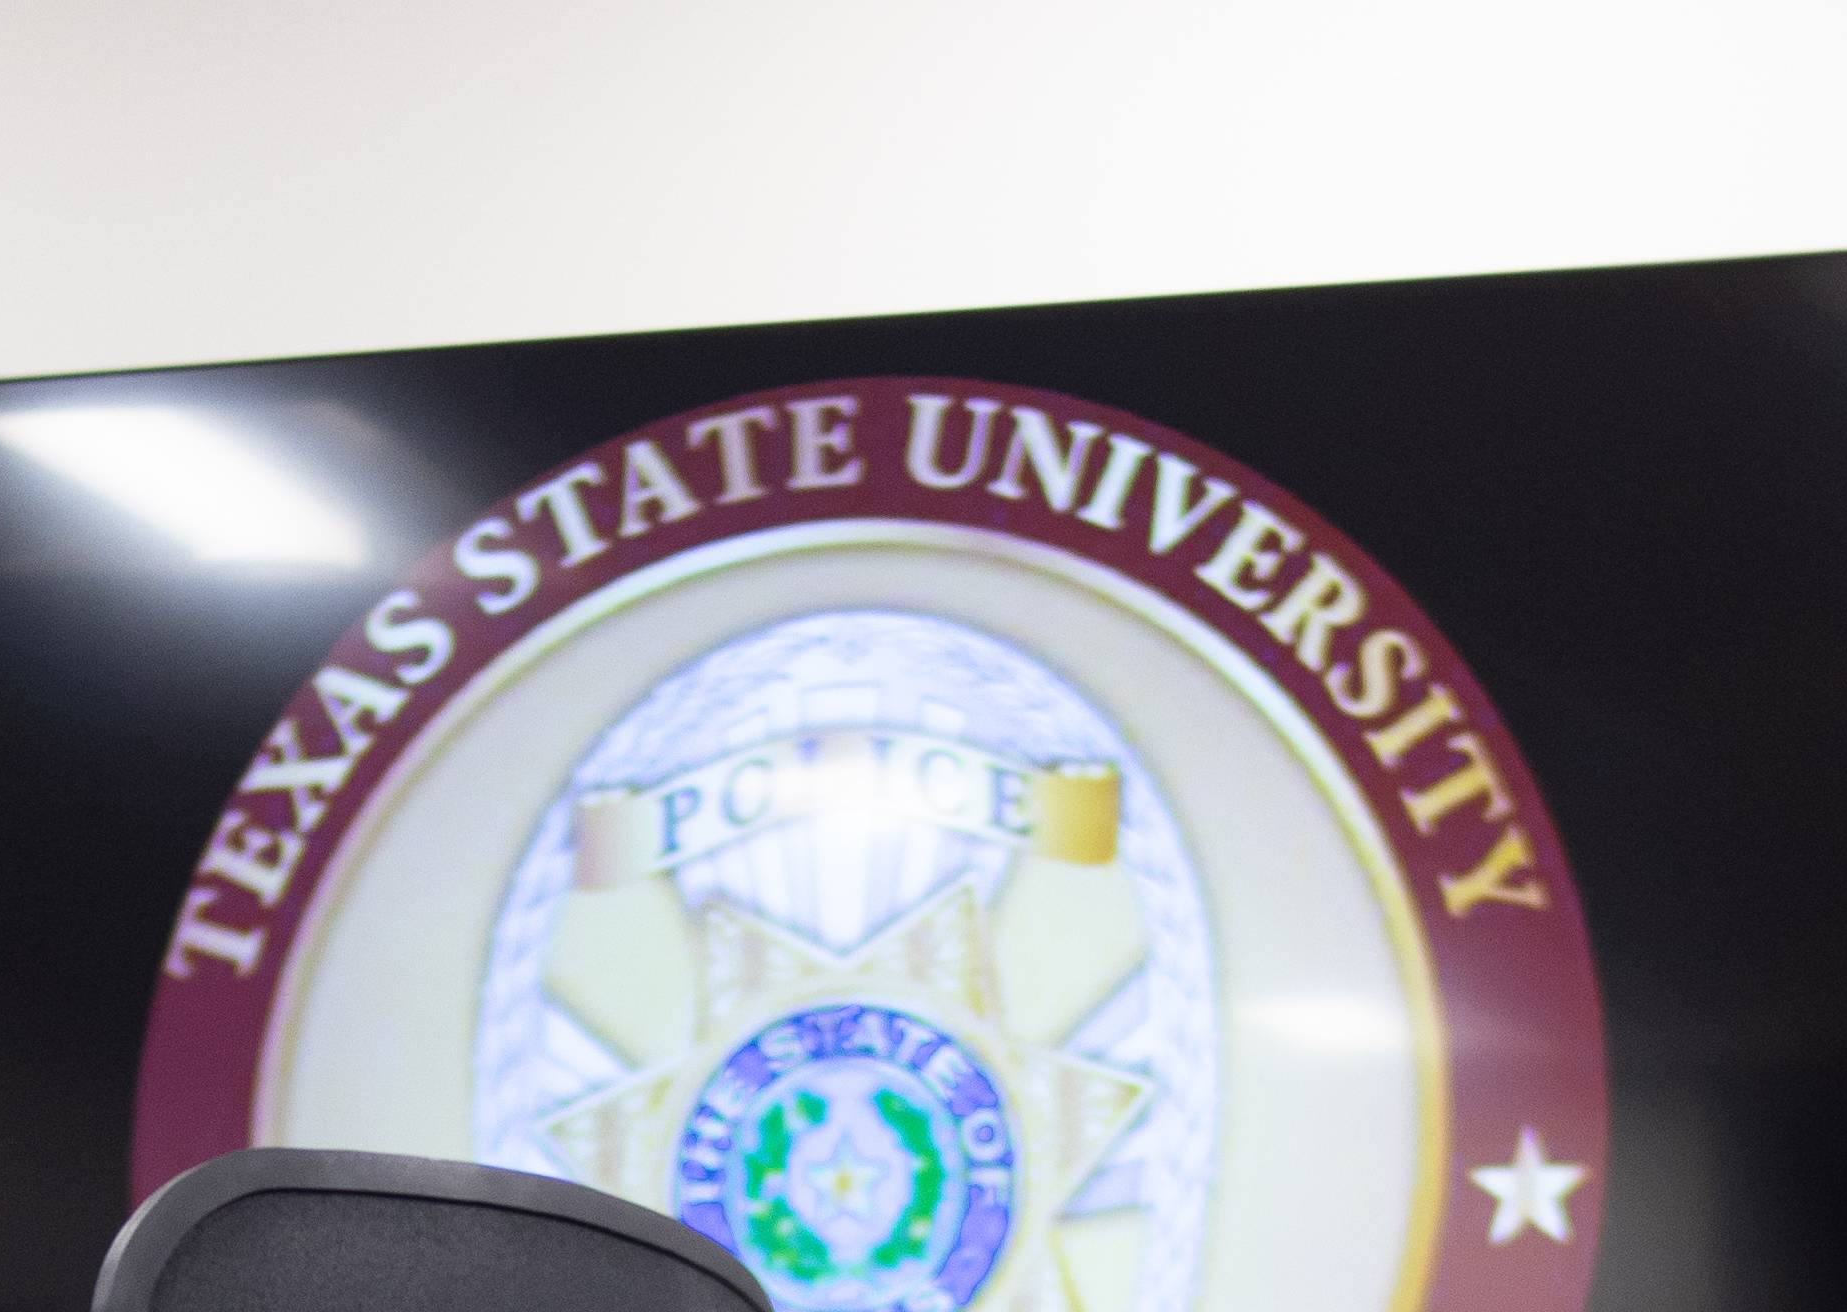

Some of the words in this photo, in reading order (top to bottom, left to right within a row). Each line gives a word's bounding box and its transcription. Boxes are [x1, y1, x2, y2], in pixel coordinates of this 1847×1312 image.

[162, 590, 455, 980] TEXAS
[454, 394, 865, 616] STATE
[904, 393, 1546, 918] UNIVERSITY
[658, 735, 1035, 855] POCE
[757, 1012, 970, 1088] STATE
